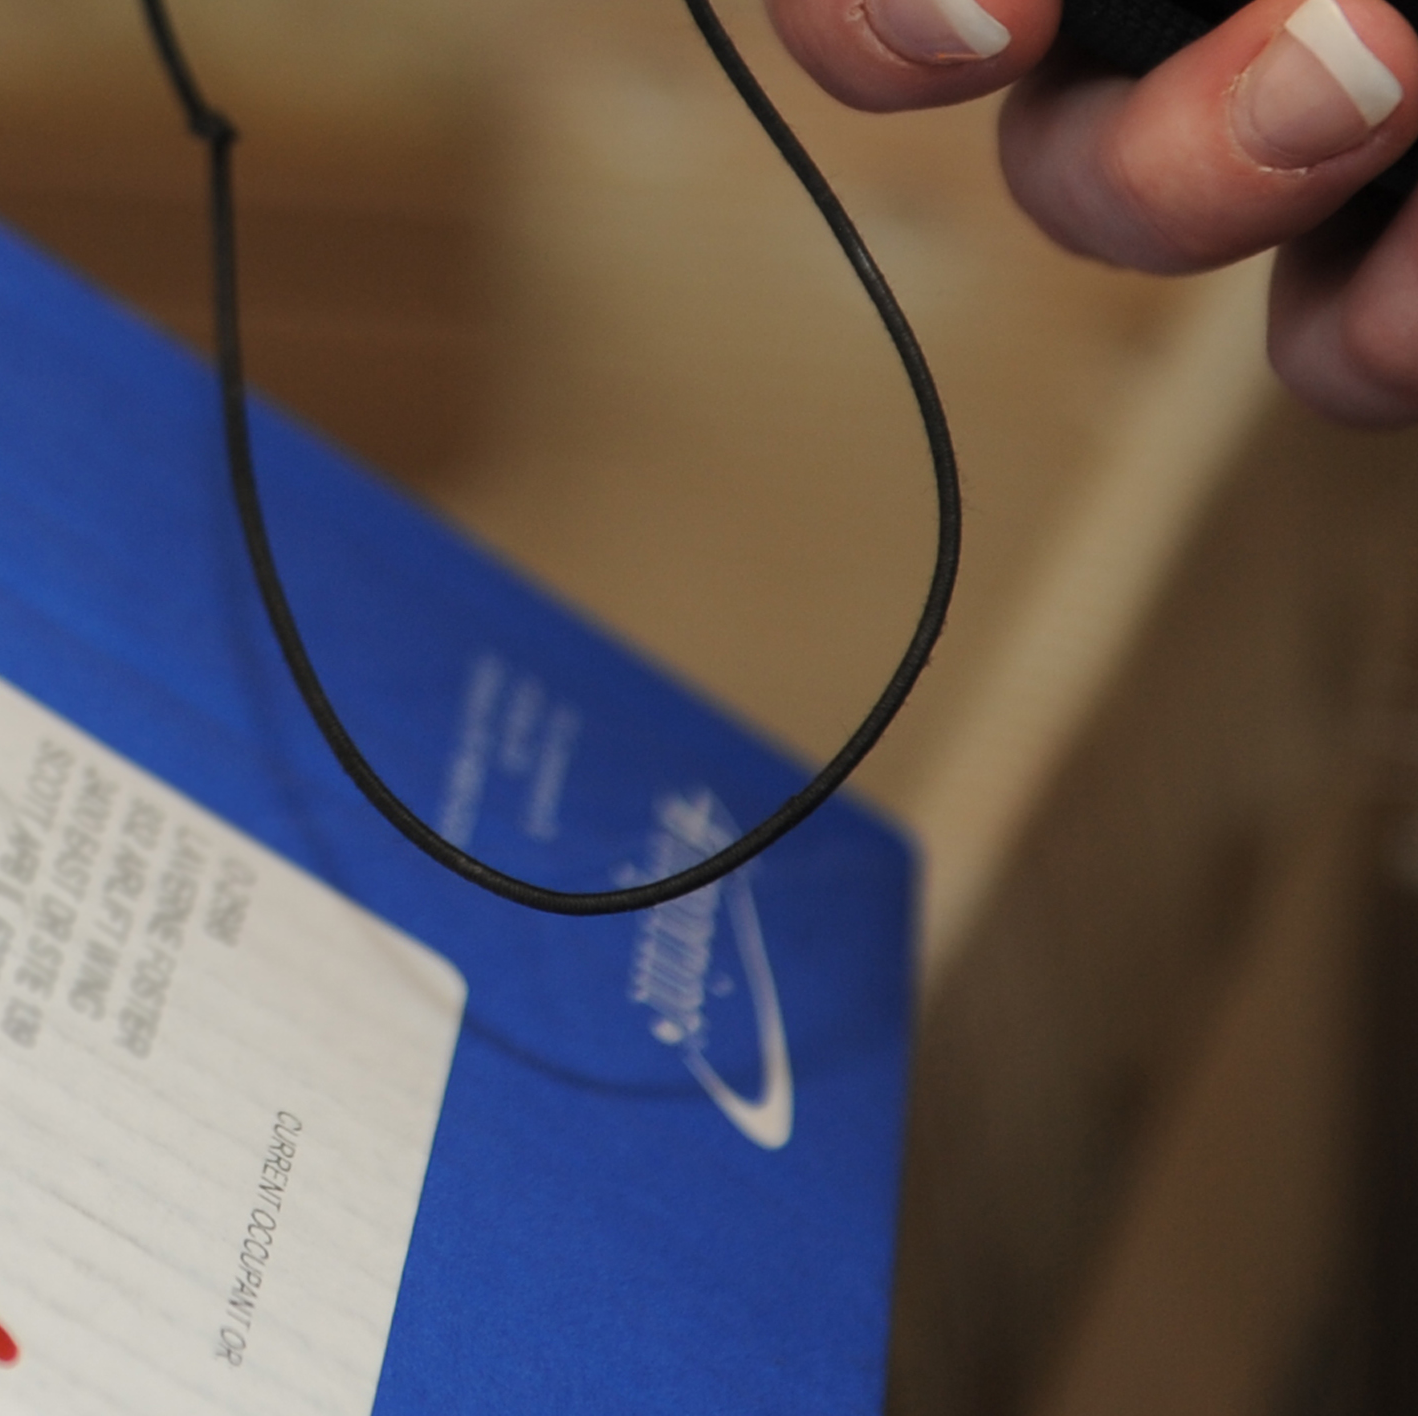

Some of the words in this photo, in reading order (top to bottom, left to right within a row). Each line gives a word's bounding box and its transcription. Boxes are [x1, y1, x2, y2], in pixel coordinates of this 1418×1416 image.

[257, 1110, 302, 1213] CURRENT
[228, 1207, 277, 1331] OCCUPANT
[215, 1326, 247, 1368] OR
